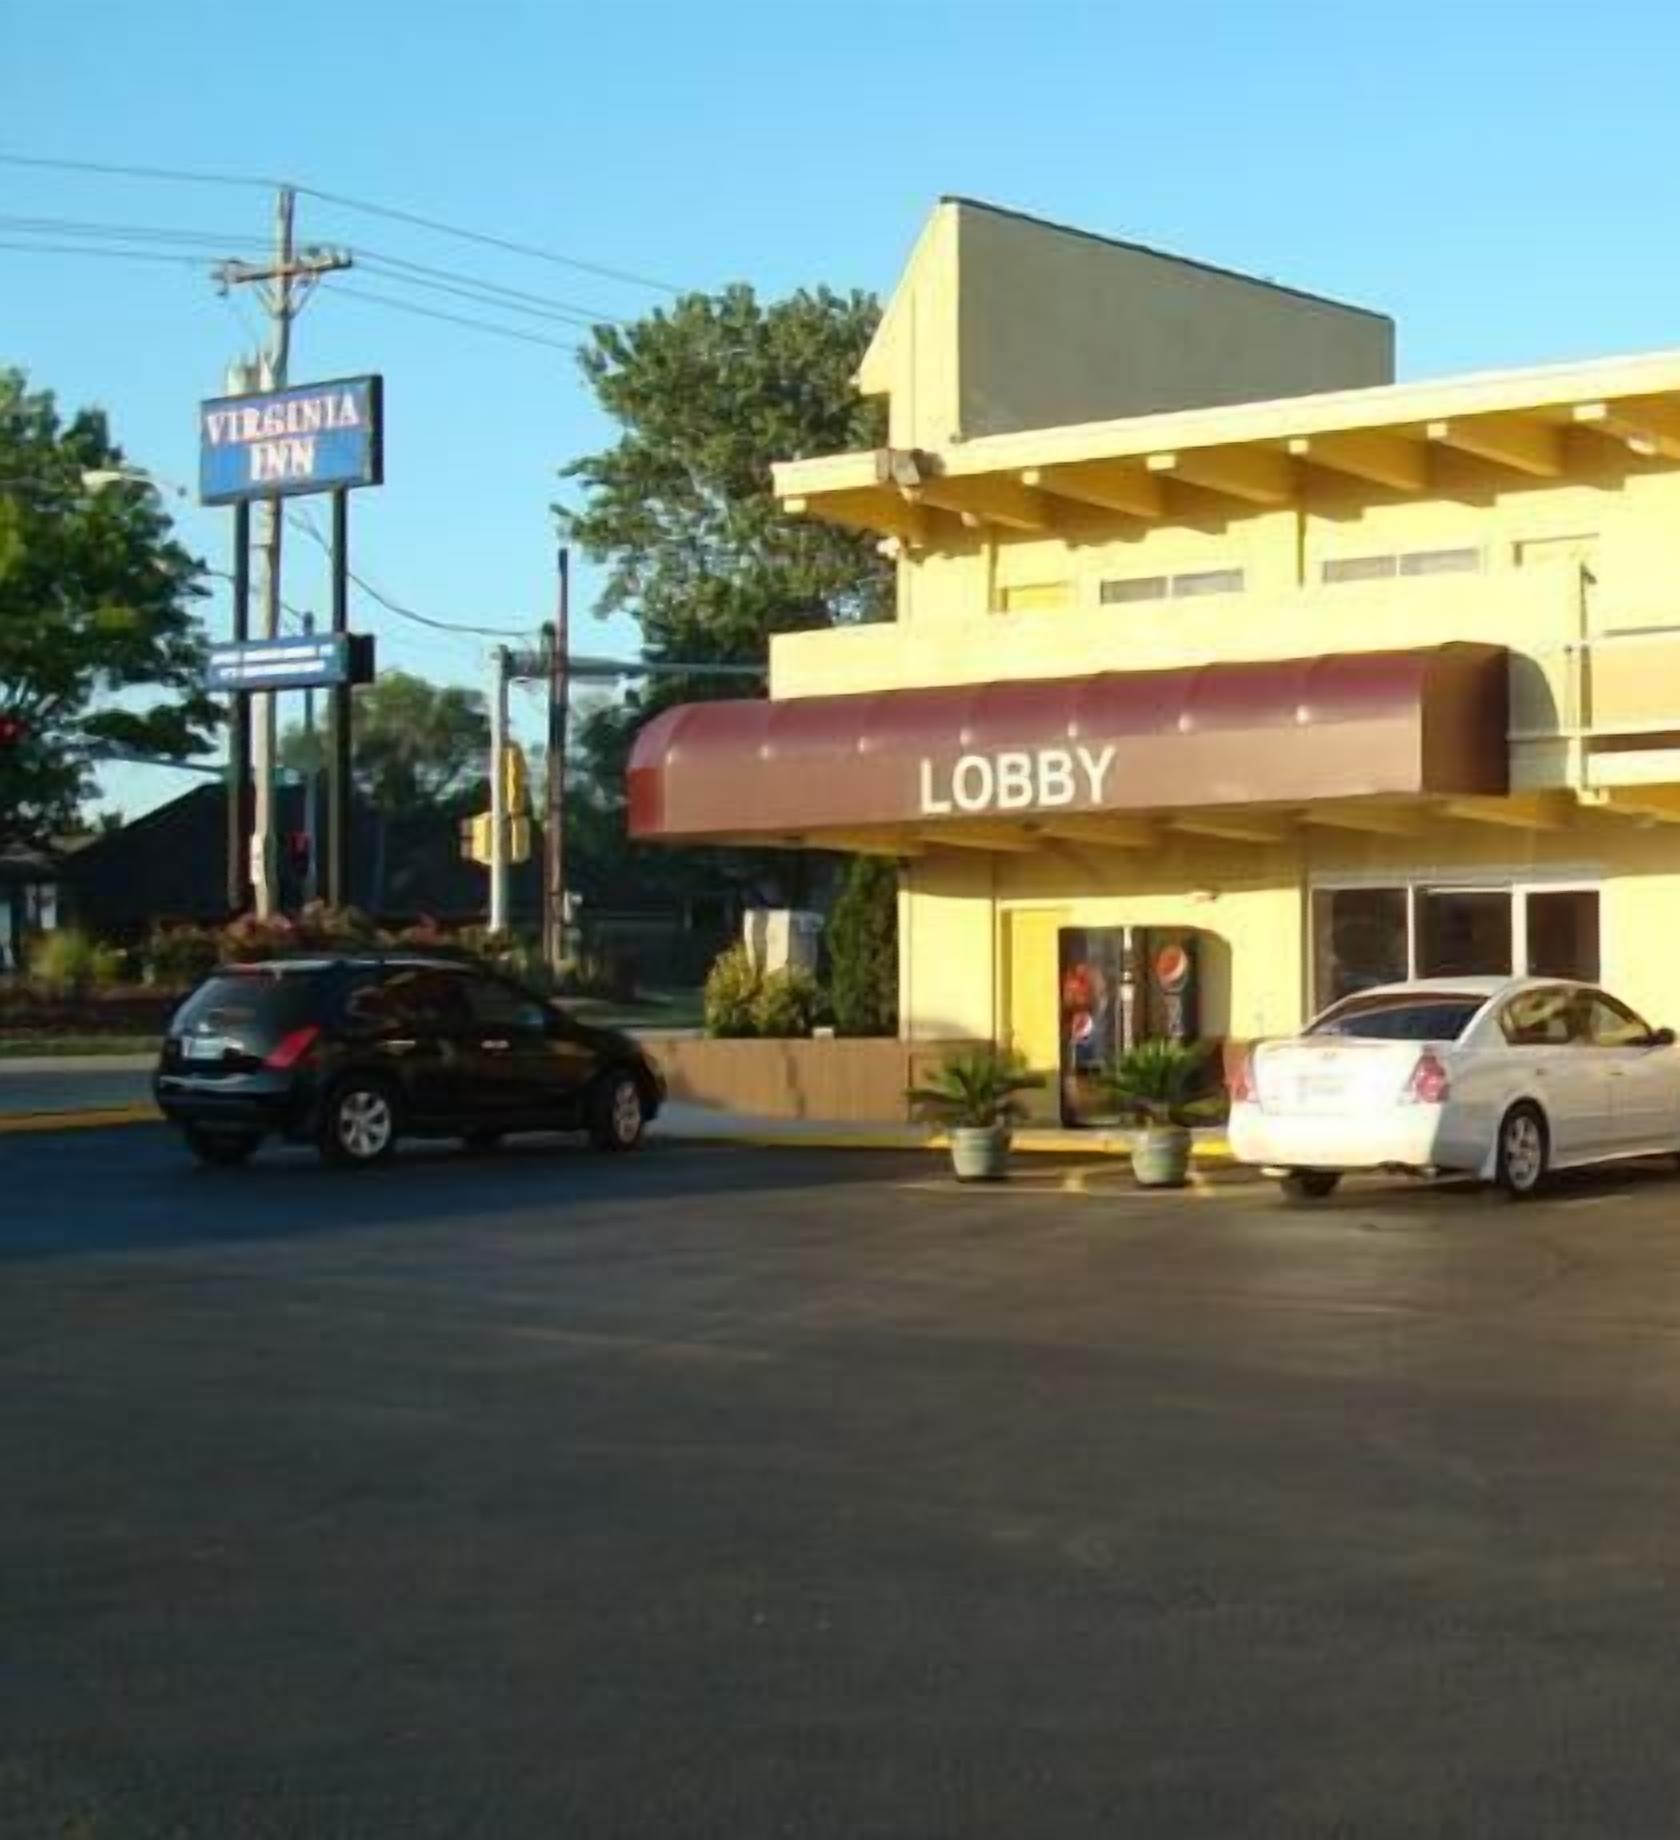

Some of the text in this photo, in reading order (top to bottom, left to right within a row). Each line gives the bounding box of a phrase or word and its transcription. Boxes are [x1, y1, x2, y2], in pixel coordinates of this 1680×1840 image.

[207, 392, 359, 445] VIRGINIA
[252, 437, 314, 481] INN
[920, 746, 1116, 814] LOBBY
